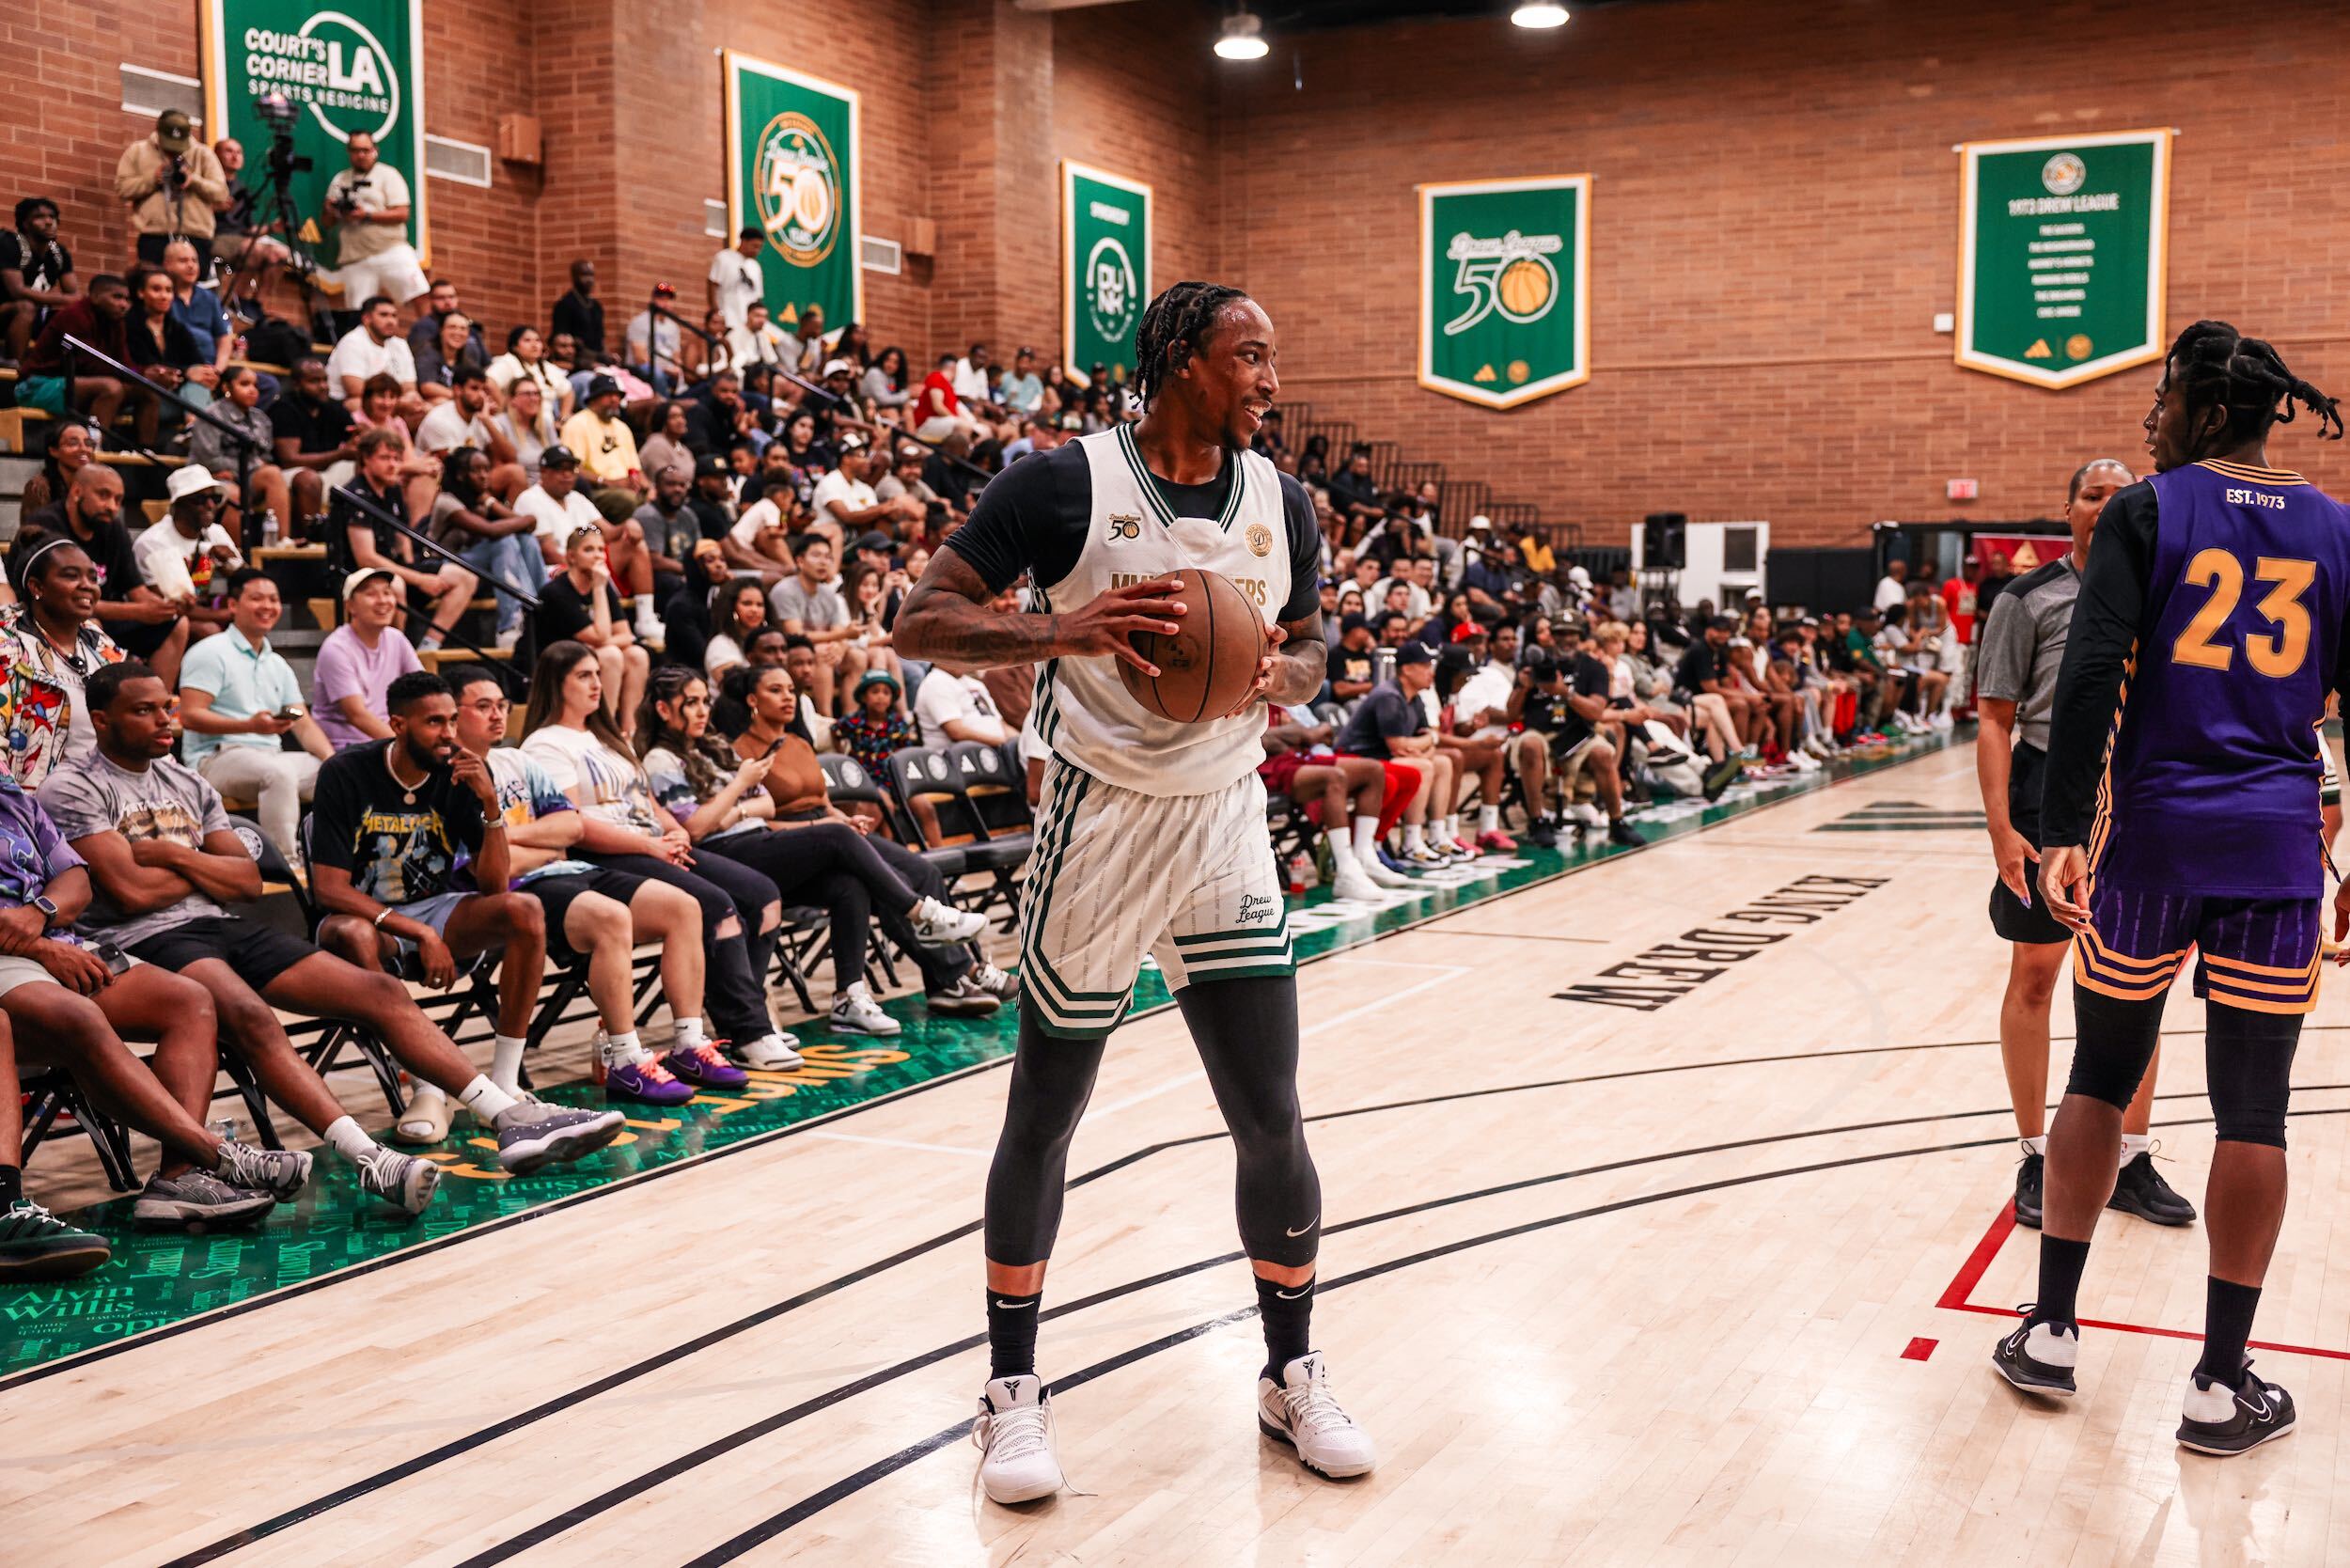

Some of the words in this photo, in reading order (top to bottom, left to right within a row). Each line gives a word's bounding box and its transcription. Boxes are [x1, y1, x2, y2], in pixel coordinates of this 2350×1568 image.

[244, 27, 326, 63] COURT'S
[245, 53, 328, 87] CORNER
[328, 40, 384, 95] LA
[316, 89, 390, 114] MEDICINE
[764, 159, 829, 233] 50
[1444, 252, 1559, 336] 50
[1108, 519, 1140, 541] 50
[2170, 547, 2317, 679] 23
[1235, 908, 1275, 924] League
[1240, 894, 1272, 909] Drew
[1717, 873, 1893, 925] KING
[1548, 928, 1794, 1011] DREW
[4, 1299, 135, 1321] Willis
[8, 1285, 134, 1306] Alvin
